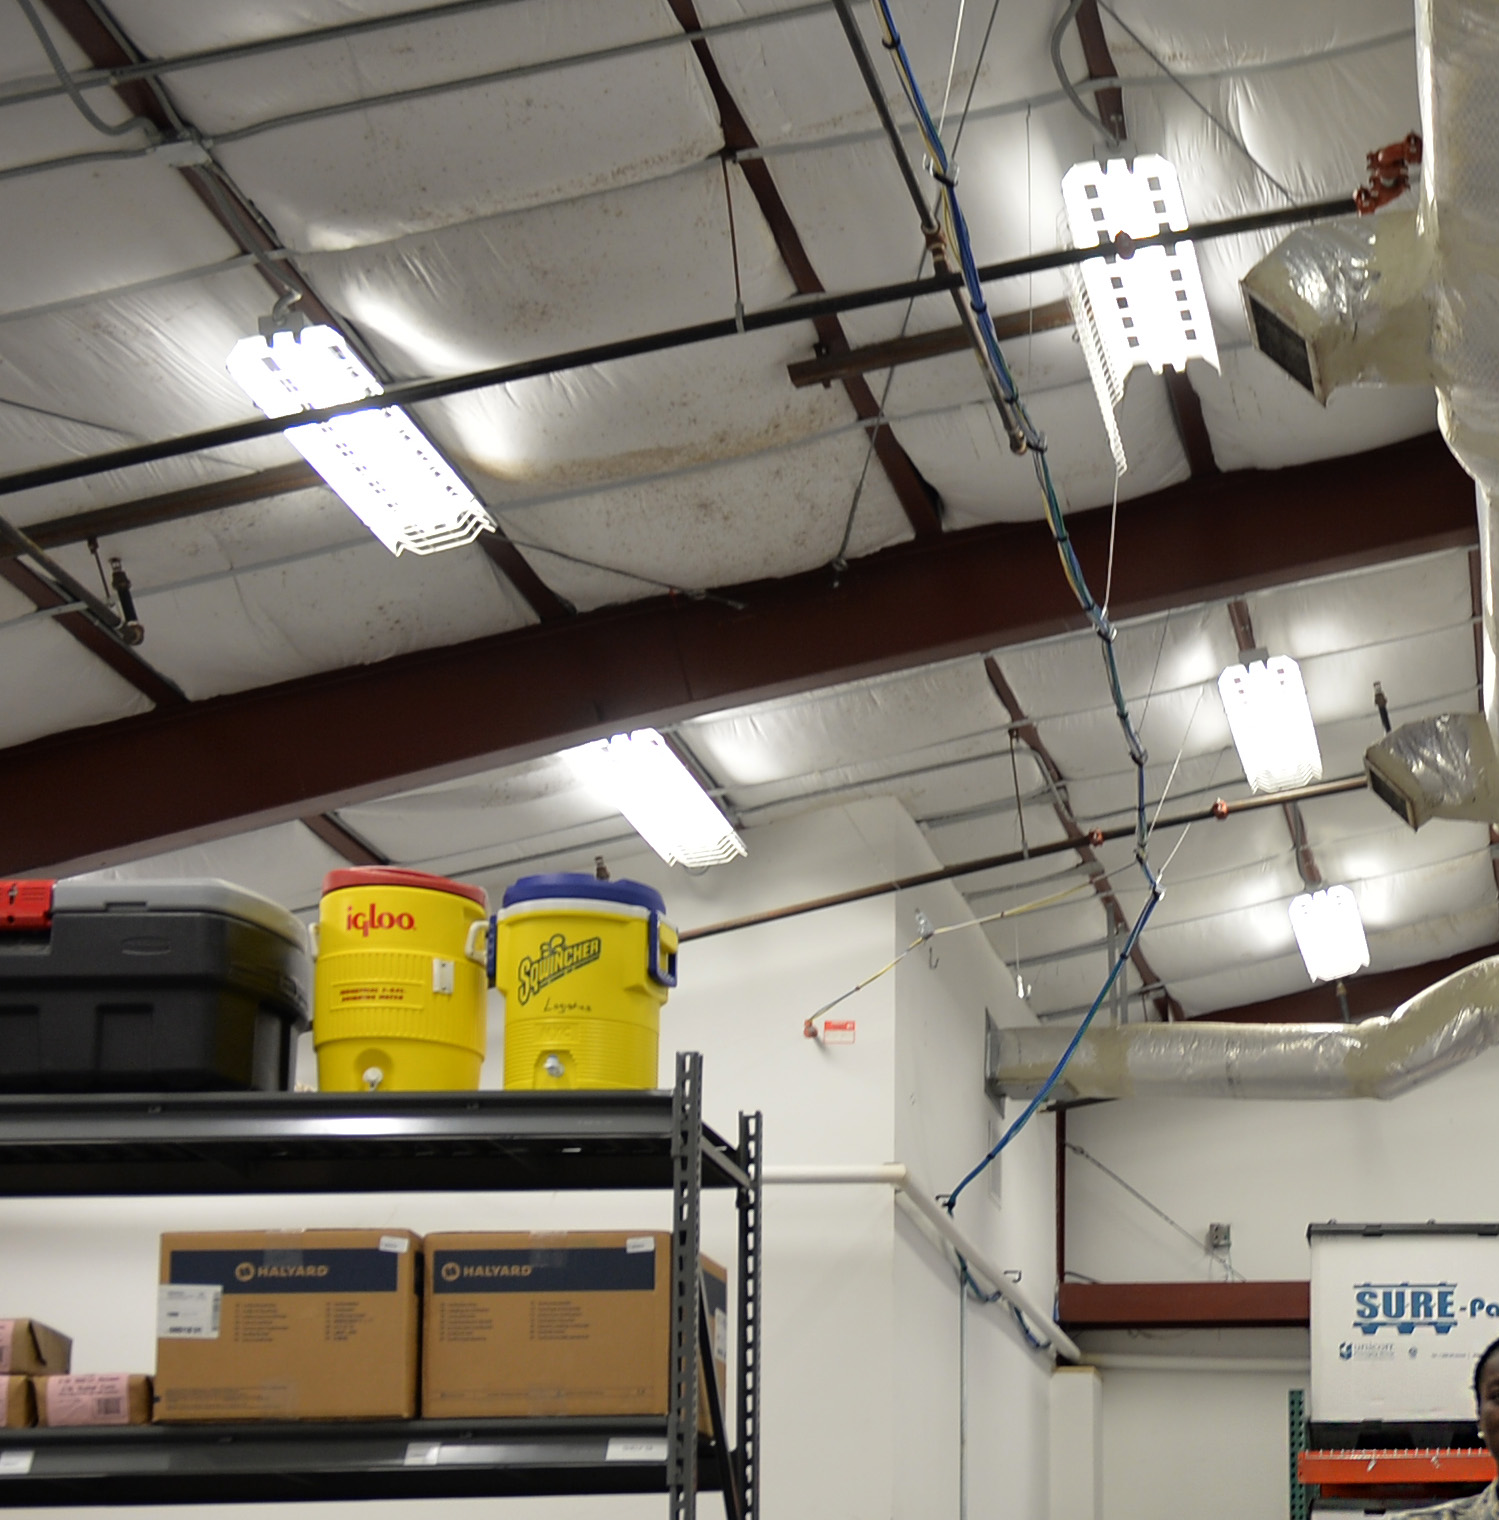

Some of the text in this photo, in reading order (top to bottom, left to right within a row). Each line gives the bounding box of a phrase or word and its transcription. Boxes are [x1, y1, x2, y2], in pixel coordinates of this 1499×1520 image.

[346, 903, 416, 937] igloo
[257, 1264, 330, 1278] HALYARD
[462, 1264, 533, 1278] HALYARD
